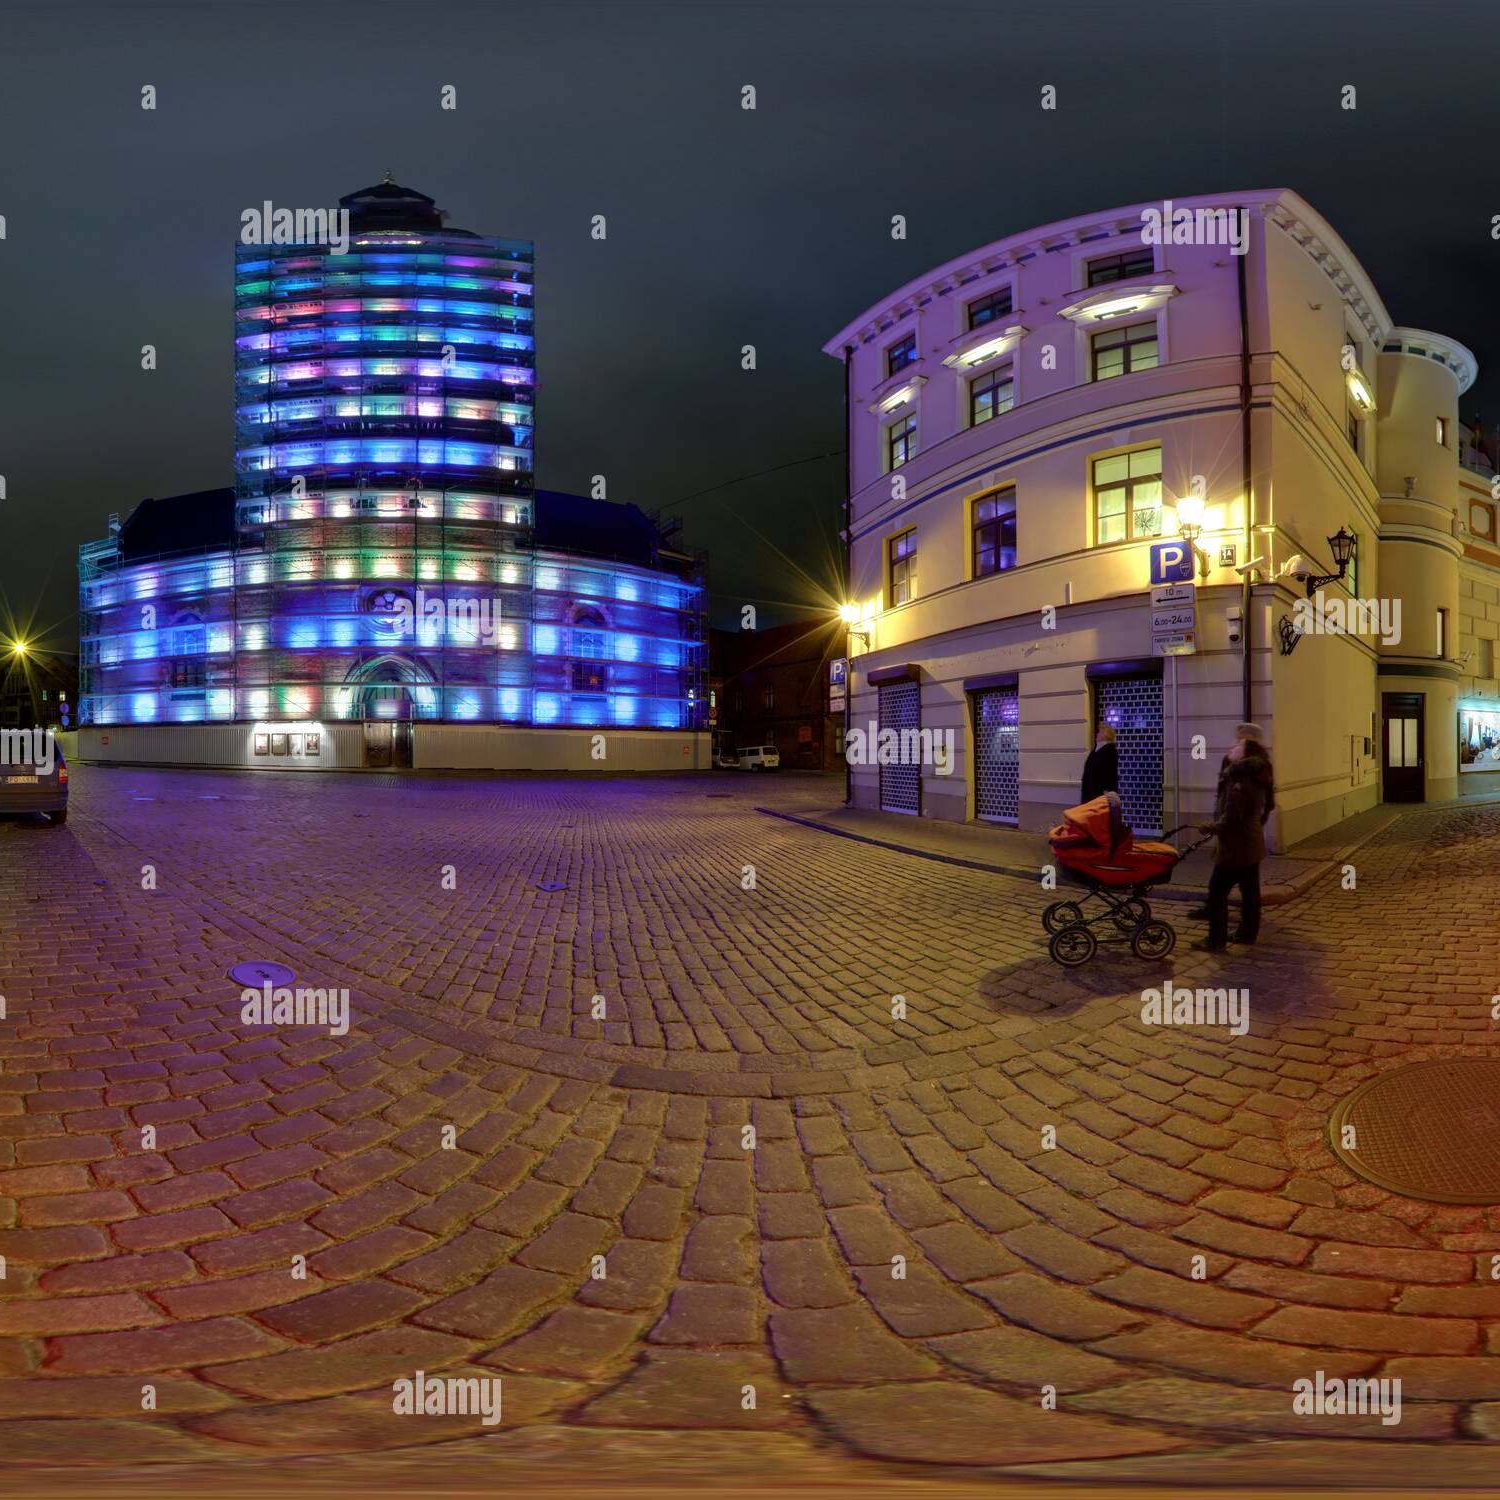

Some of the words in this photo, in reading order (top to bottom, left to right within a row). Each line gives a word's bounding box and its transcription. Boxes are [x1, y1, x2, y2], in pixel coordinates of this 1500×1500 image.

[1160, 547, 1183, 578] P
[1165, 588, 1174, 596] 10
[834, 662, 842, 681] P
